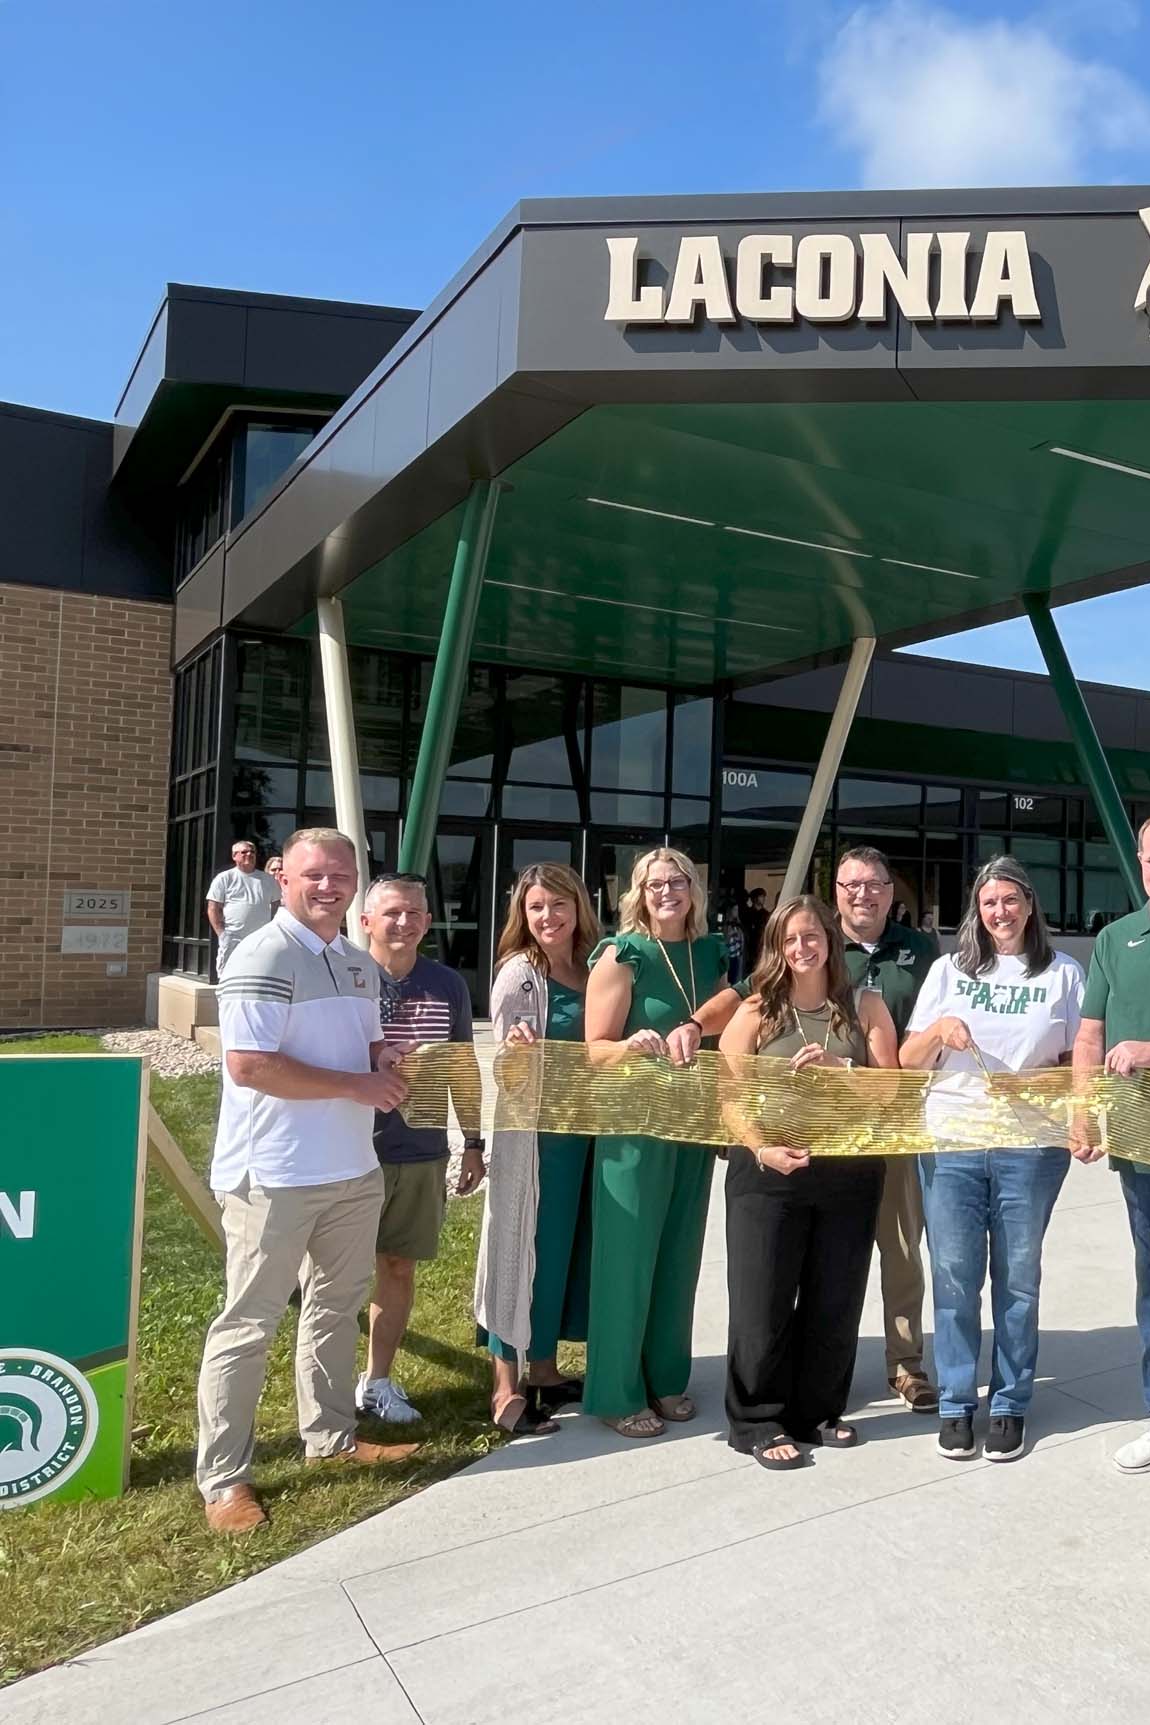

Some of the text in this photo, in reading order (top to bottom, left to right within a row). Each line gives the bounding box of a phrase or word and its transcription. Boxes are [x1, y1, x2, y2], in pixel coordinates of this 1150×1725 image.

[604, 230, 1042, 323] LACONIA
[722, 770, 759, 788] 100A
[1014, 797, 1034, 810] 102
[75, 898, 118, 910] 2025
[30, 1364, 83, 1425] BRANDON
[0, 1441, 76, 1497] DISTRICT
